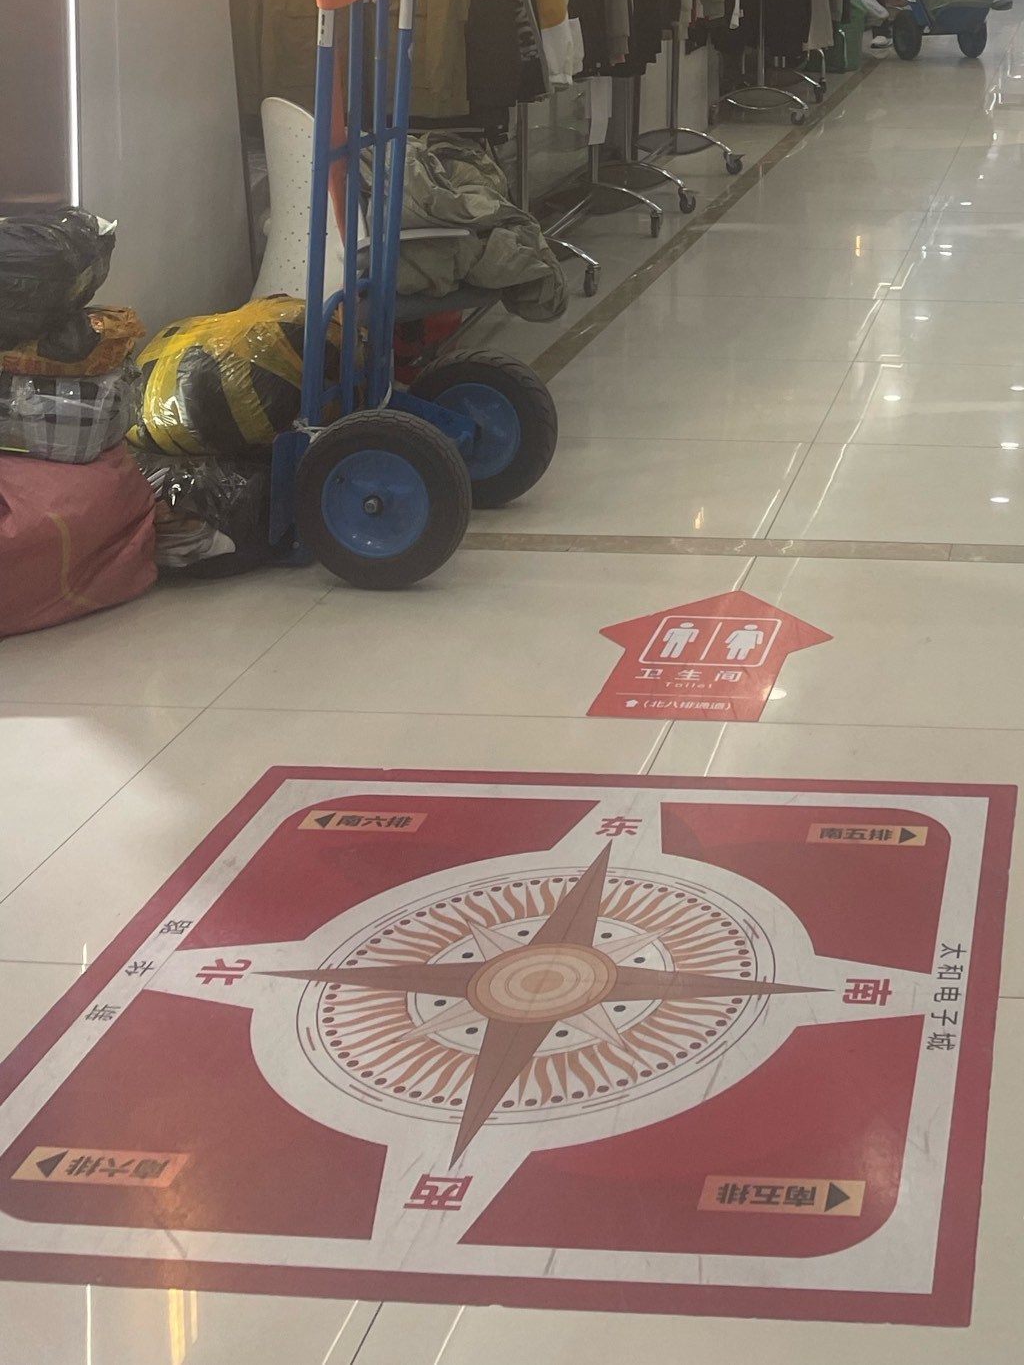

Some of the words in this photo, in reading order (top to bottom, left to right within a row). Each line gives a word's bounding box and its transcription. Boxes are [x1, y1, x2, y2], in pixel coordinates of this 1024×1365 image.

[635, 668, 743, 683] 卫生间
[334, 809, 413, 831] 南六排
[594, 814, 645, 840] 东
[817, 824, 893, 844] 南五排
[195, 956, 247, 986] 北
[841, 977, 893, 1007] 南
[925, 941, 970, 1054] 太和电子城
[64, 1153, 172, 1180] 南六排
[403, 1172, 474, 1212] 西
[716, 1180, 819, 1208] 南五排
